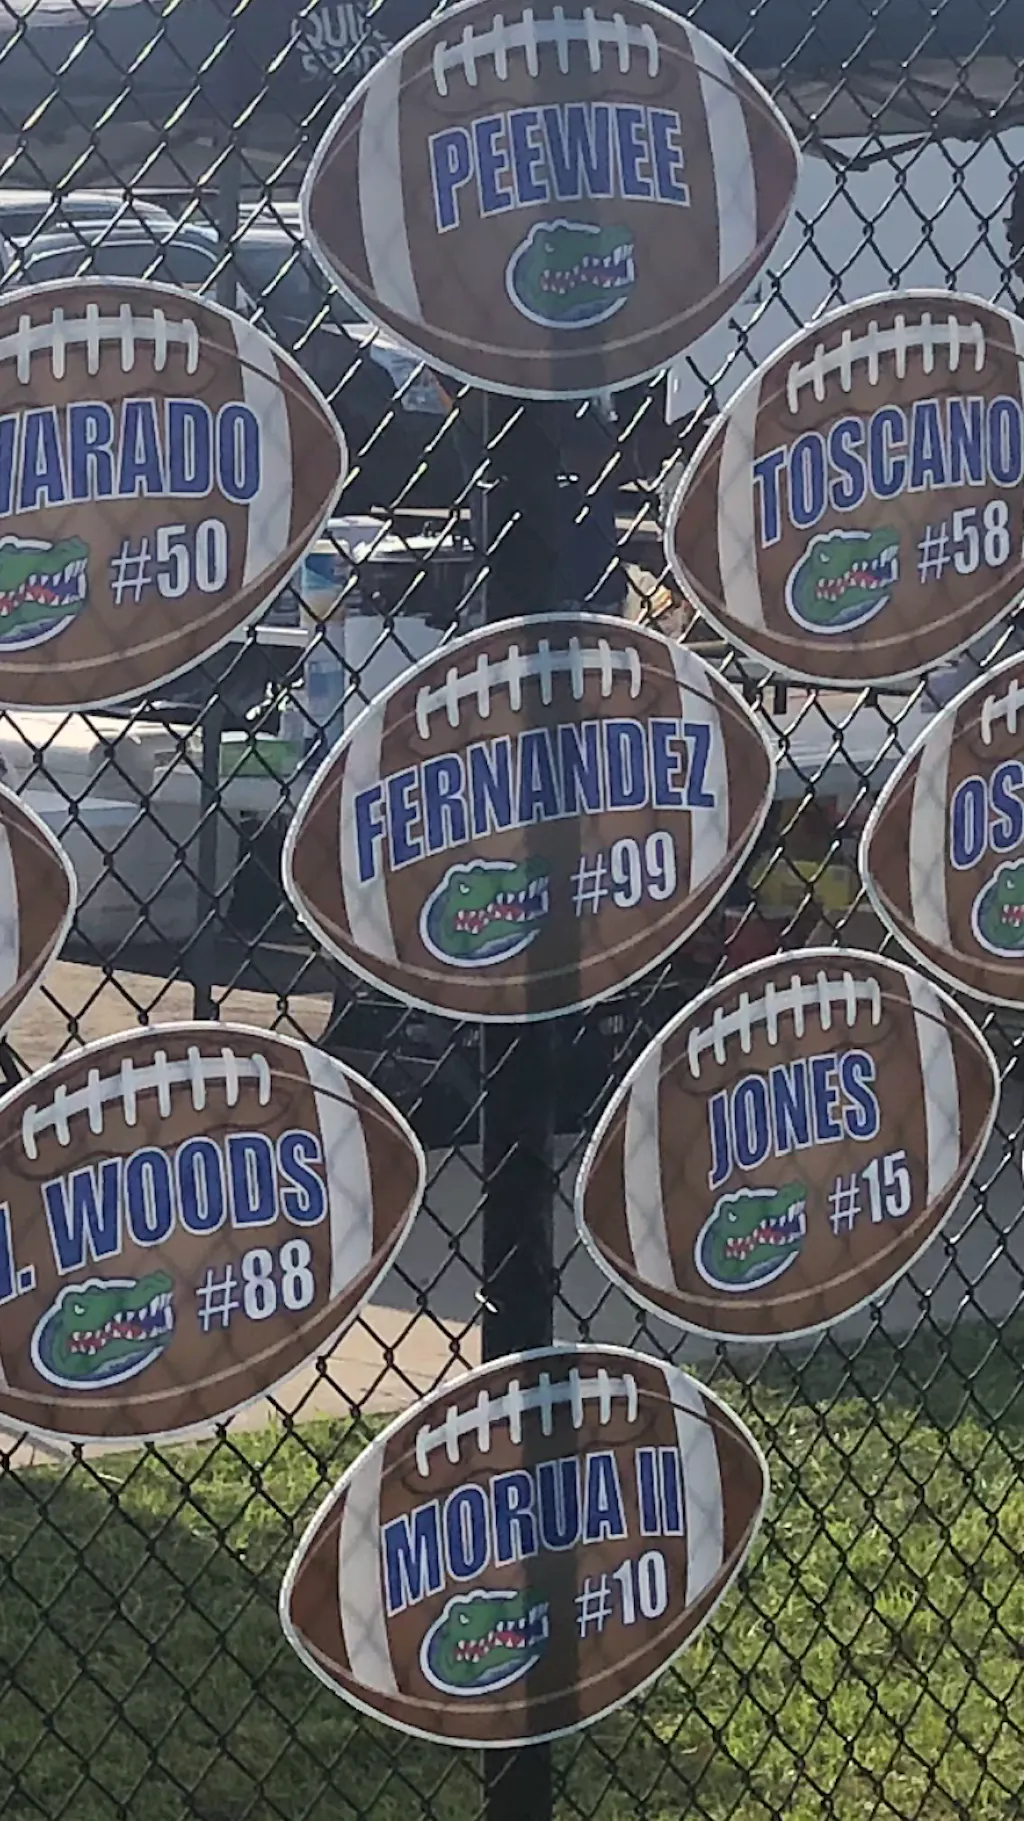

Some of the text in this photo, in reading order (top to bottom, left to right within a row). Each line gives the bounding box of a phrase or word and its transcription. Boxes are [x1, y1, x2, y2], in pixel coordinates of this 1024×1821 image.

[428, 102, 691, 233] PEEWEE
[753, 395, 1024, 548] TOSCANO
[111, 519, 228, 604] #50
[917, 500, 1009, 583] #58
[354, 717, 719, 883] FERNANDEZ
[571, 831, 677, 916] #99
[706, 1049, 881, 1190] JONES
[41, 1129, 328, 1275] WOODS
[829, 1150, 912, 1235] #15
[196, 1238, 315, 1331] #88
[381, 1446, 685, 1617] MORUA II
[575, 1550, 669, 1637] #10
